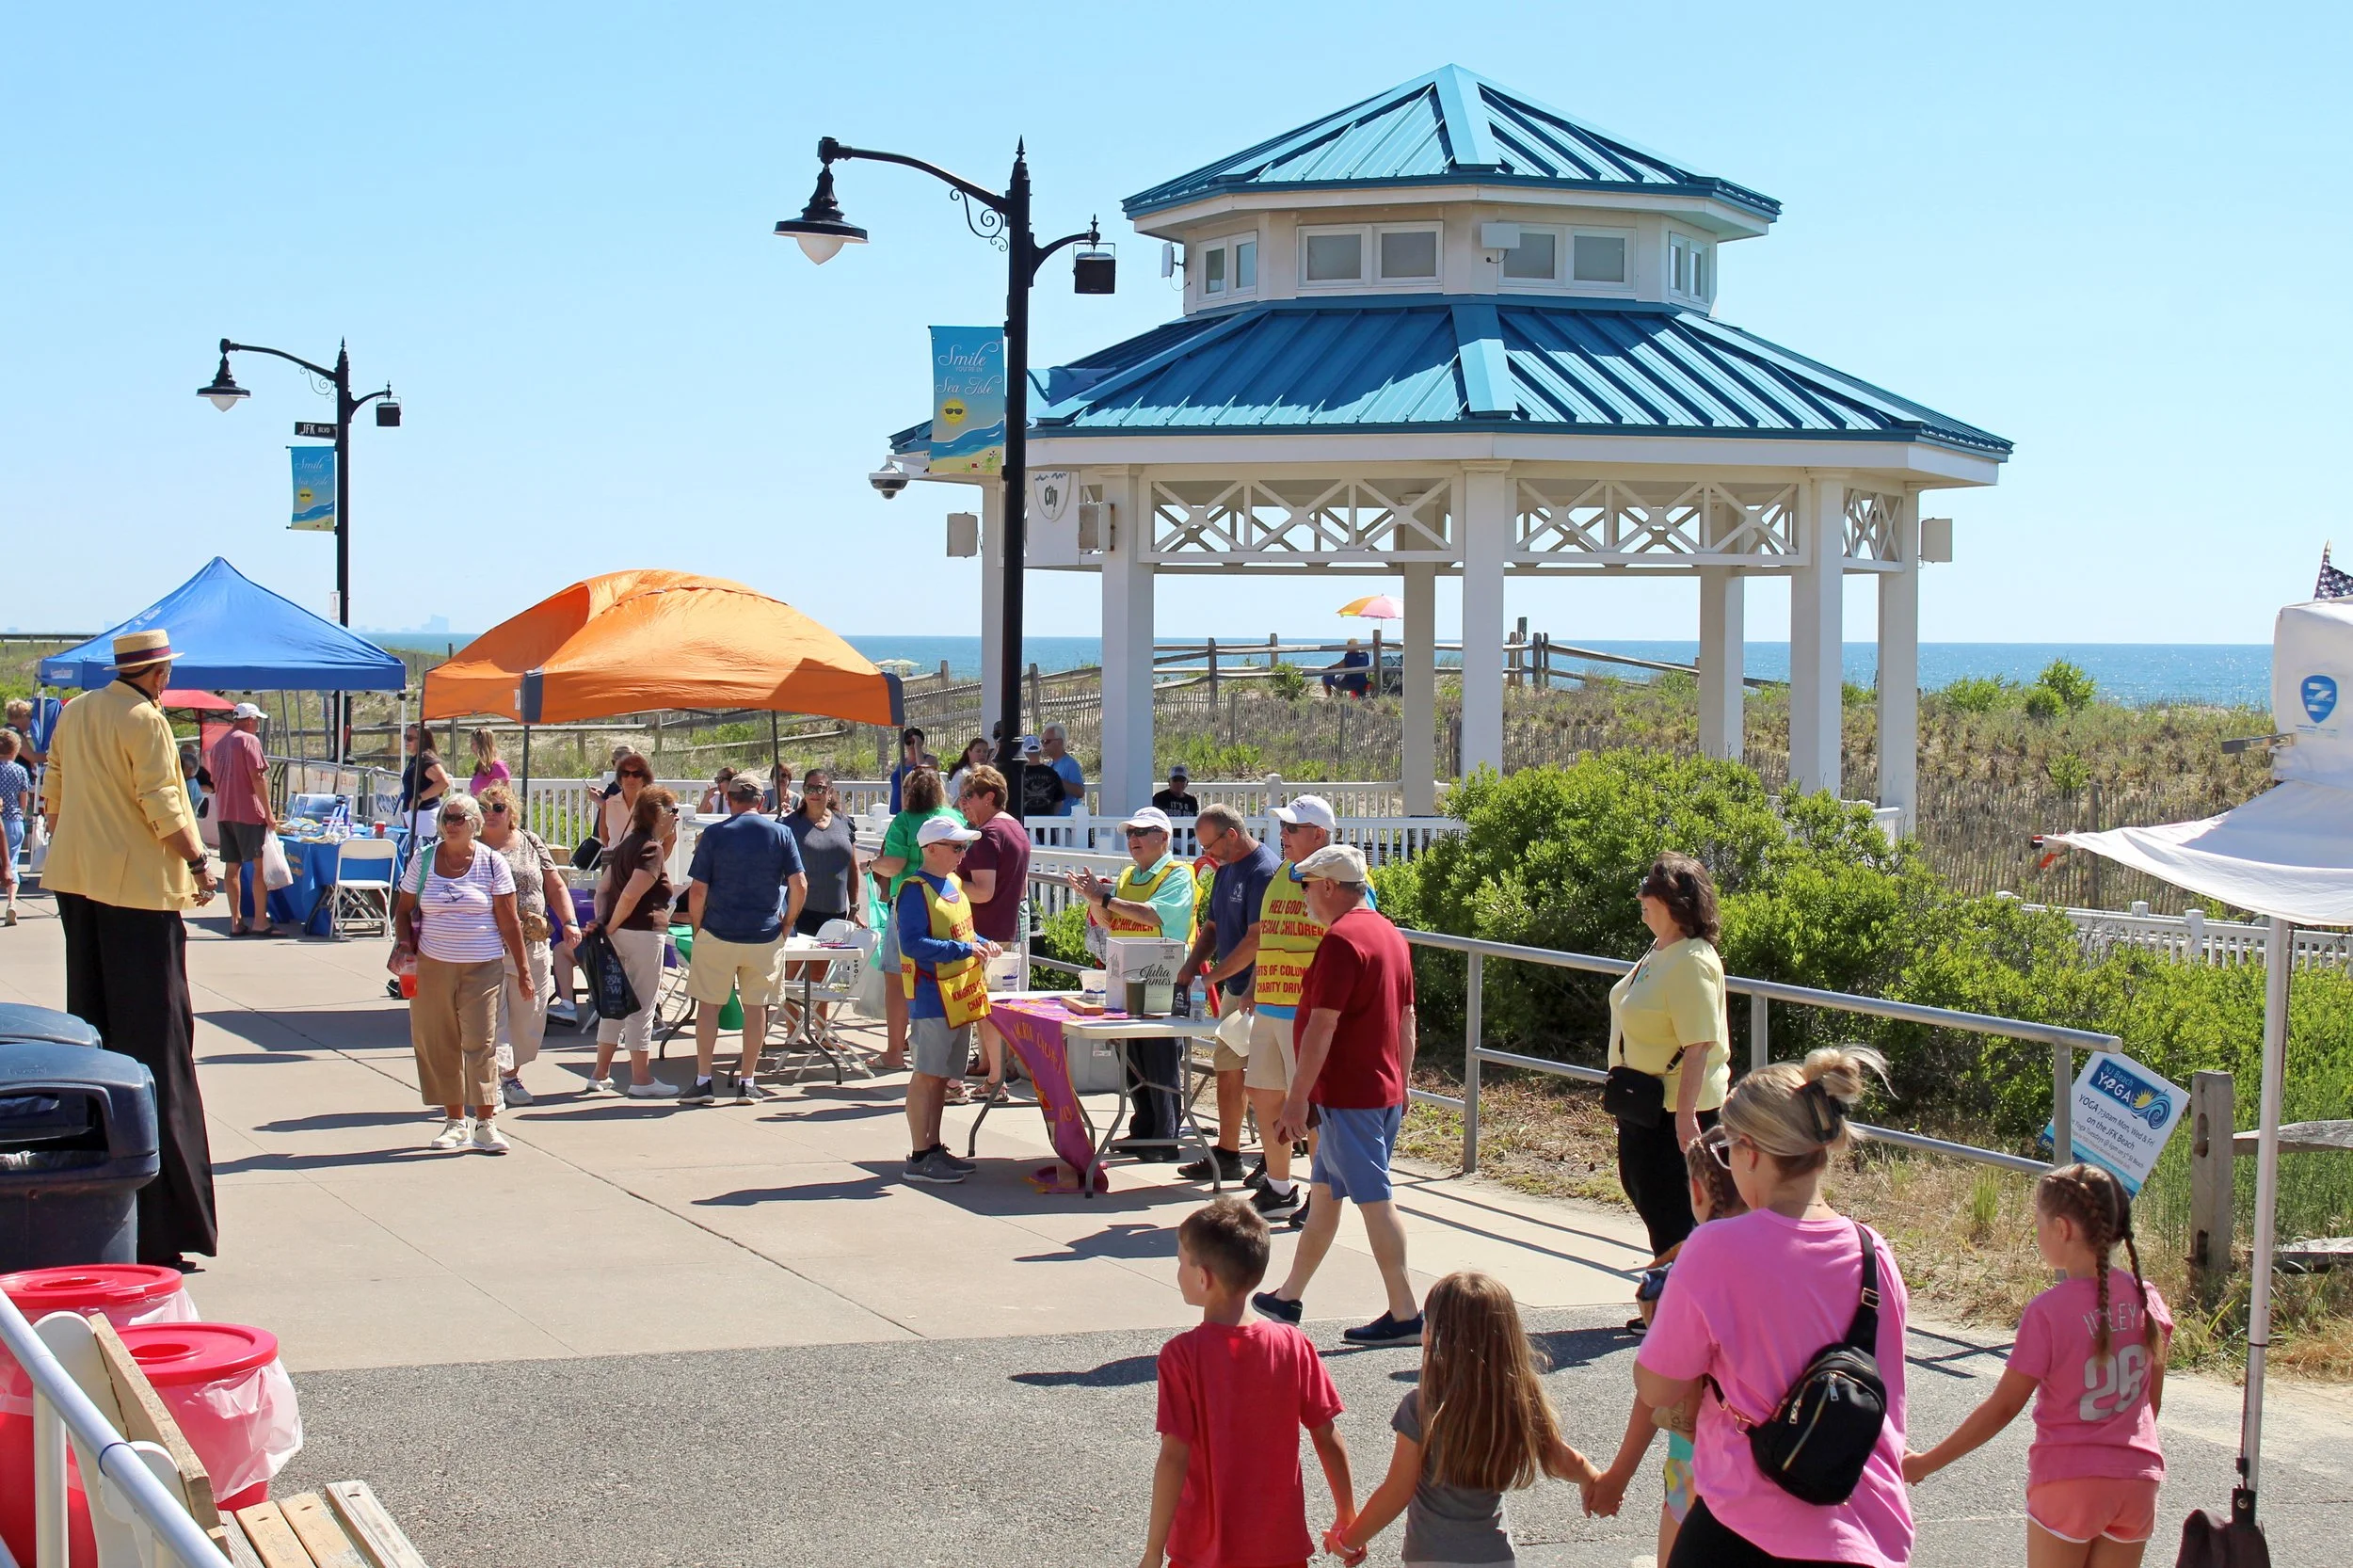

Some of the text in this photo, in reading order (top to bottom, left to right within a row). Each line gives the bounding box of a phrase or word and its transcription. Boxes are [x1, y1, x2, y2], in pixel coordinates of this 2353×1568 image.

[938, 342, 999, 366] Smile
[936, 375, 1002, 395] Sea Isle
[299, 424, 315, 435] JFK
[1045, 485, 1058, 510] City
[1170, 801, 1183, 809] IT'S
[1260, 919, 1323, 937] PECIAL CHILDREN
[1124, 963, 1171, 981] Julia
[1270, 965, 1278, 976] OF
[1280, 965, 1306, 978] COLUM
[1283, 982, 1303, 995] DRIV
[2098, 1071, 2131, 1103] YOGA
[2104, 1064, 2134, 1087] NJ Beach
[2078, 1094, 2099, 1112] YOGA
[2097, 1107, 2118, 1124] 7:30am
[2115, 1118, 2131, 1133] Mon,
[2130, 1128, 2143, 1140] Wed
[2086, 1115, 2096, 1126] on
[2094, 1120, 2107, 1132] the
[2104, 1126, 2118, 1140] JFK
[2116, 1134, 2136, 1150] Beach
[2082, 1303, 2137, 1339] ULEY
[2079, 1345, 2147, 1421] 26
